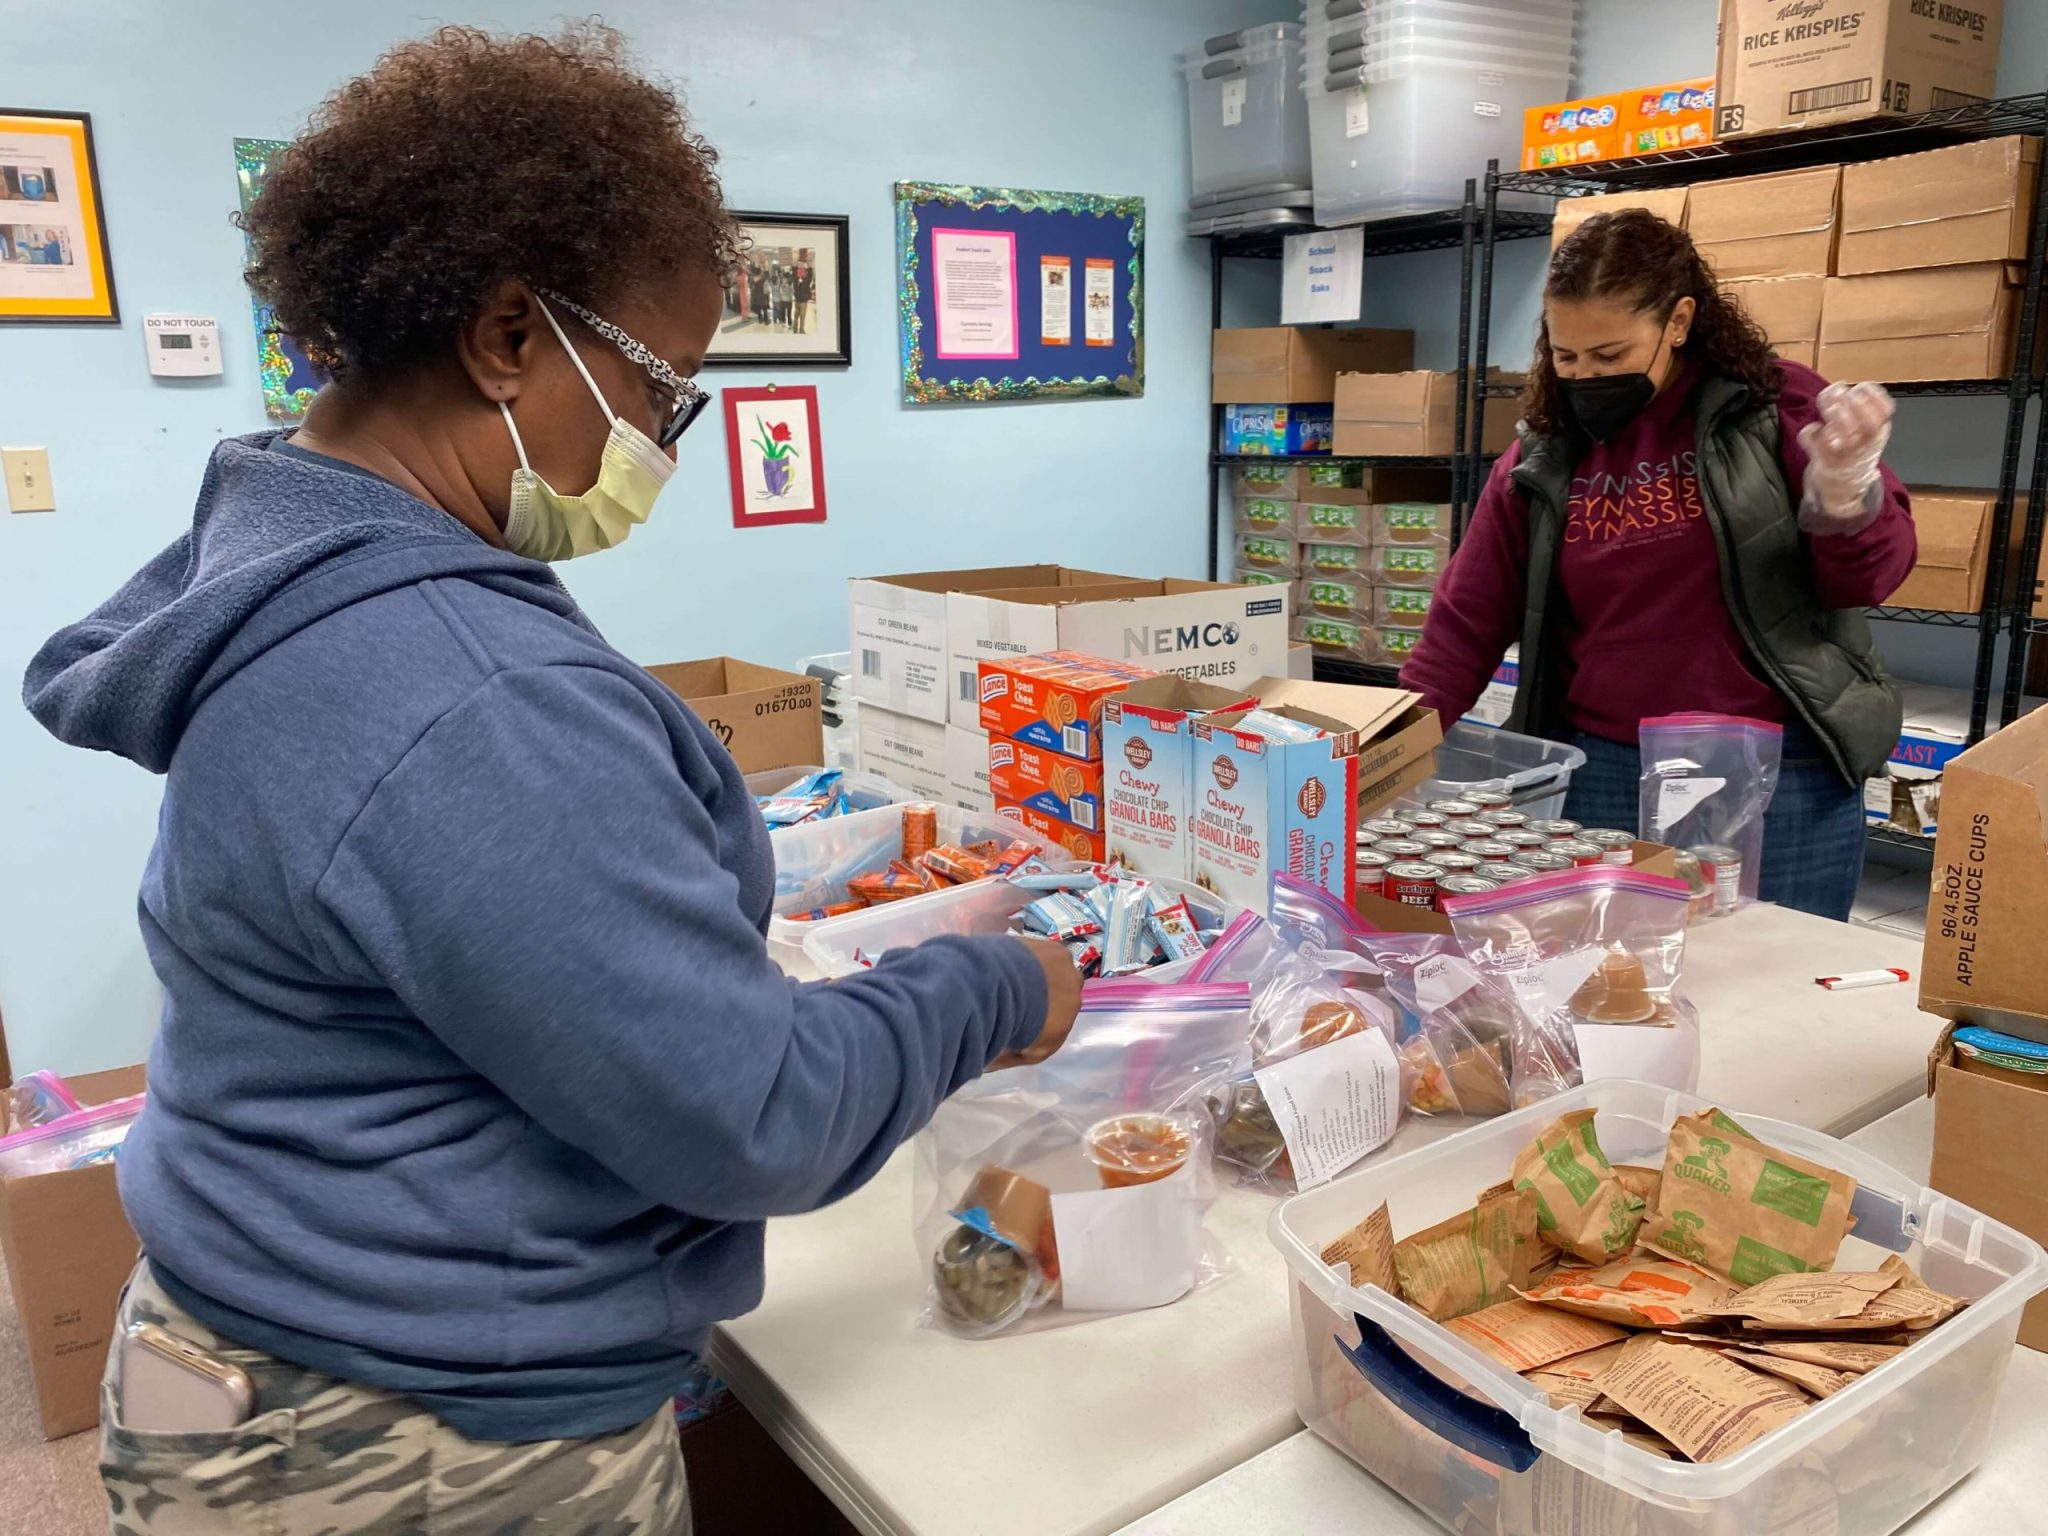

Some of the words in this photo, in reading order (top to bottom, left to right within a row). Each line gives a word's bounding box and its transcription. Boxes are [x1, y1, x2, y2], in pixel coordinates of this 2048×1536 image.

[1910, 0, 1936, 19] RICE
[1938, 3, 1985, 32] KRISPIES
[1744, 30, 1780, 51] RICE
[1785, 13, 1862, 43] KRISPIES
[1882, 79, 1892, 110] 4
[1720, 108, 1743, 132] FS
[1308, 245, 1336, 256] School
[1309, 264, 1334, 275] Snack
[878, 618, 887, 626] CUT
[888, 619, 902, 630] GREEN
[904, 622, 918, 632] BEANS
[976, 640, 992, 649] MIXED
[994, 641, 1027, 654] VEGETABLES
[782, 684, 812, 698] 19320
[984, 678, 1006, 694] Lance
[1013, 678, 1034, 694] Toast
[755, 698, 812, 716] 01670.00
[1160, 722, 1176, 732] BARS
[884, 739, 892, 748] CUT
[894, 742, 908, 754] GREEN
[908, 746, 924, 758] BEANS
[992, 748, 1012, 761] Lance
[1126, 746, 1150, 760] WELLSLEY
[1245, 740, 1260, 752] BARS
[1019, 748, 1040, 764] Toast
[1214, 764, 1237, 778] WELLSLEY
[1120, 770, 1160, 797] Chewy
[1666, 784, 1688, 792] Ziploc
[1114, 788, 1150, 810] CHOCOLATE
[1151, 800, 1168, 813] CHIP
[1207, 789, 1244, 820] Chewy
[1308, 778, 1317, 816] WELLSLEY
[1028, 813, 1048, 830] Toast
[1110, 800, 1146, 826] GRANOLA
[1150, 812, 1176, 832] BARS
[1201, 808, 1234, 832] CHOCOLATE
[1236, 822, 1252, 836] CHIP
[1196, 820, 1231, 849] GRANOLA
[1234, 834, 1260, 859] BARS
[1969, 814, 1990, 862] CUPS
[1396, 884, 1435, 895] Southgat
[1962, 868, 1984, 926] SAUCE
[1401, 895, 1430, 904] BEEF
[1942, 862, 1963, 938] 96/4.5OZ.
[1957, 932, 1977, 986] APPLE
[1420, 962, 1446, 978] Ziploc
[1516, 974, 1544, 986] Ziploc
[1674, 1163, 1731, 1194] QUAKER
